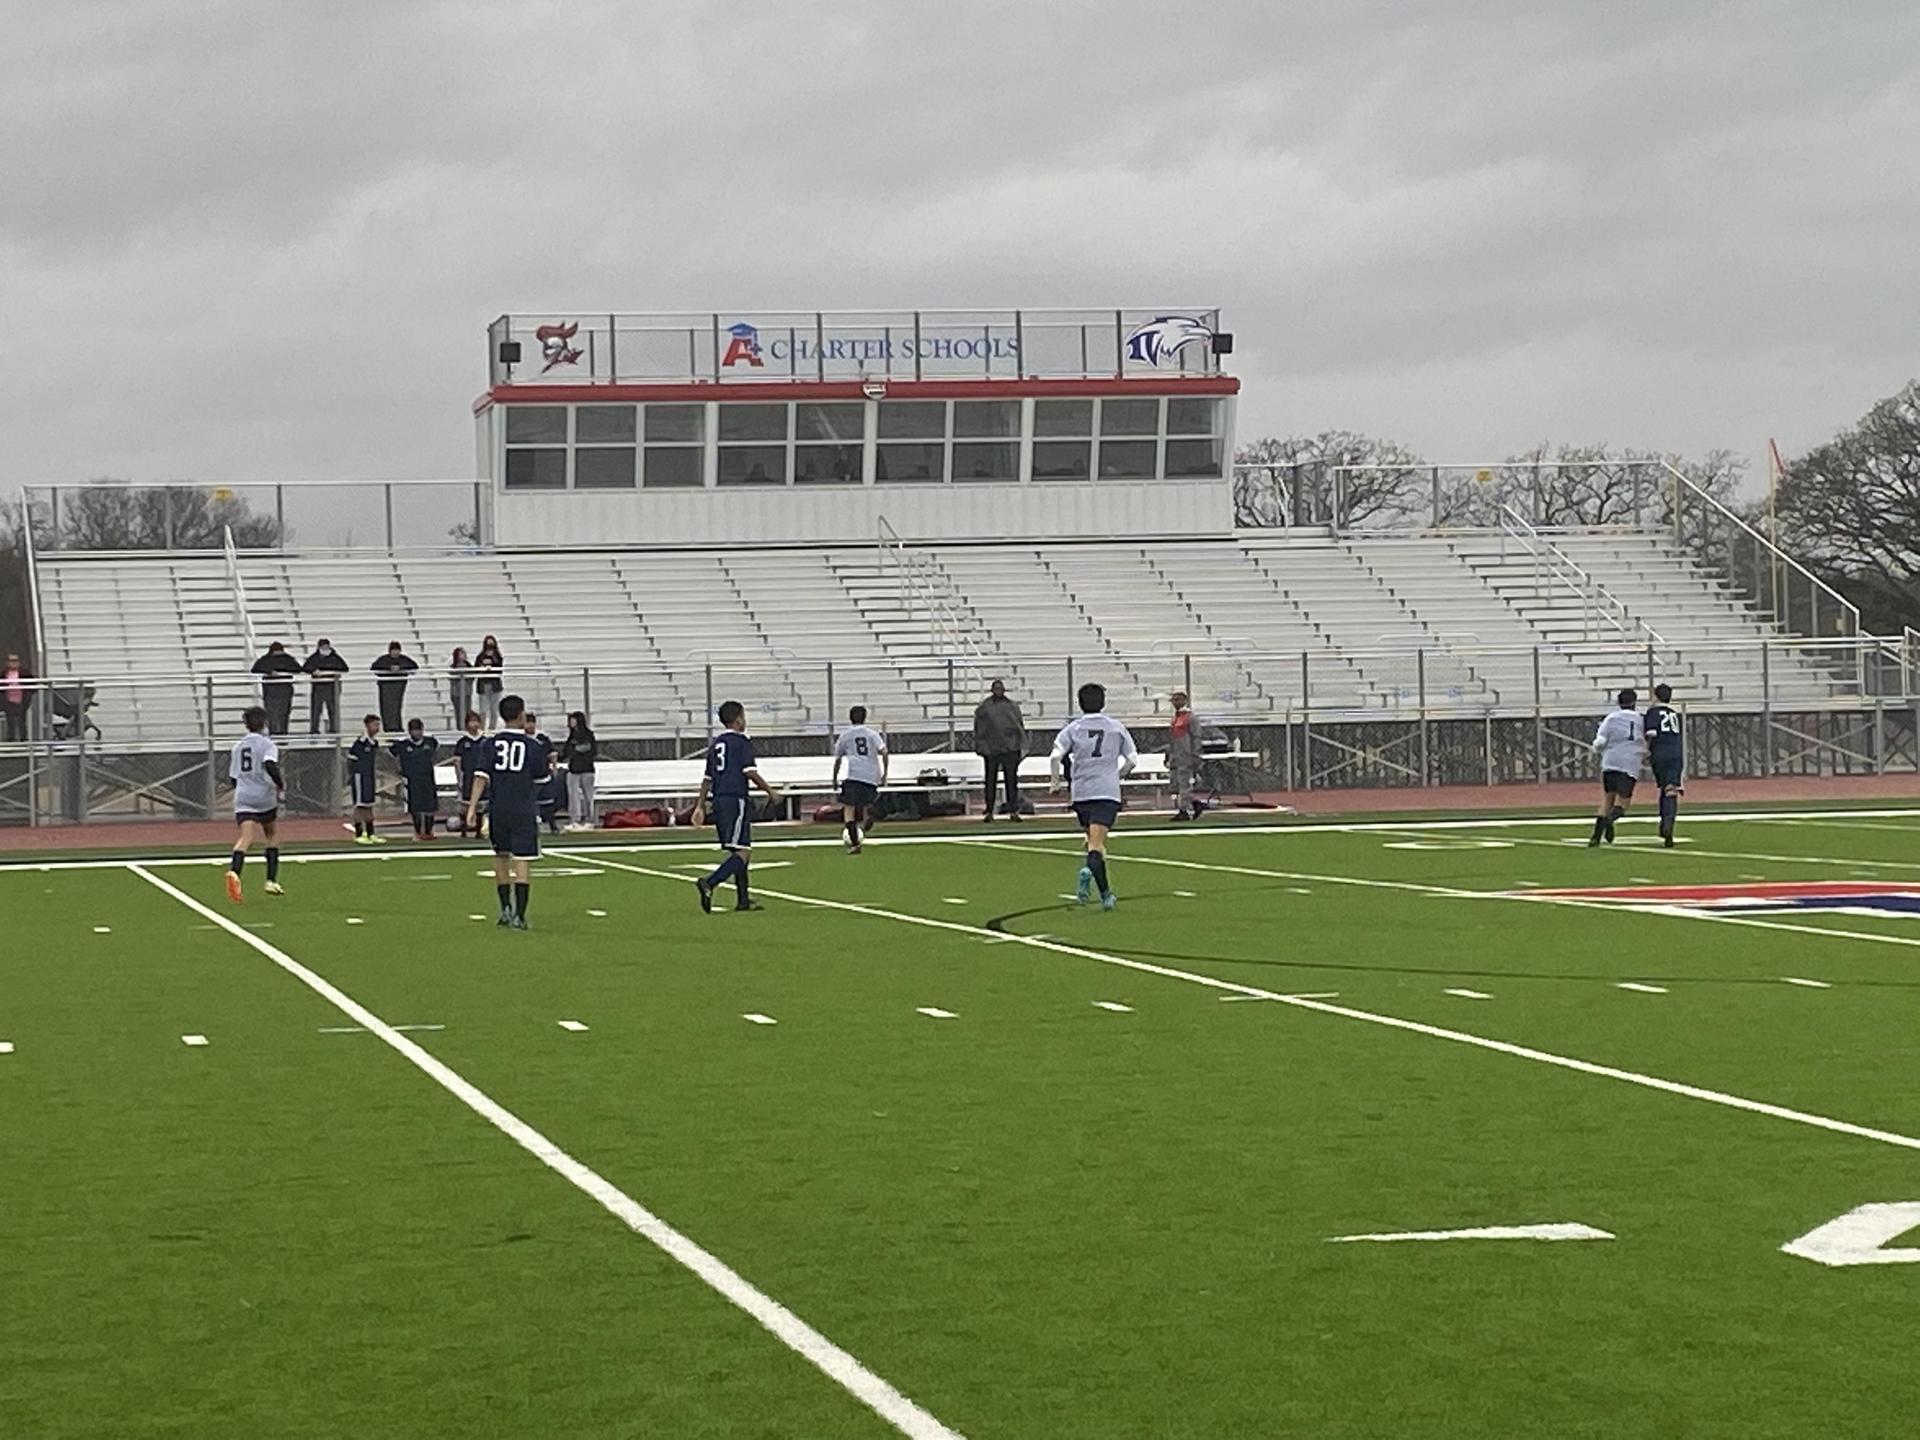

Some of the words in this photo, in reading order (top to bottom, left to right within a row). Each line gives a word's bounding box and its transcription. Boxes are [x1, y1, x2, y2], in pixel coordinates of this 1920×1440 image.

[770, 338, 893, 360] CHARTER
[900, 337, 1019, 359] SCHOOLS
[1628, 720, 1635, 741] 1
[1659, 710, 1680, 734] 20
[494, 740, 526, 772] 30
[854, 736, 869, 757] 8
[1088, 730, 1104, 757] 7
[240, 746, 253, 773] 6
[715, 742, 726, 772] 3
